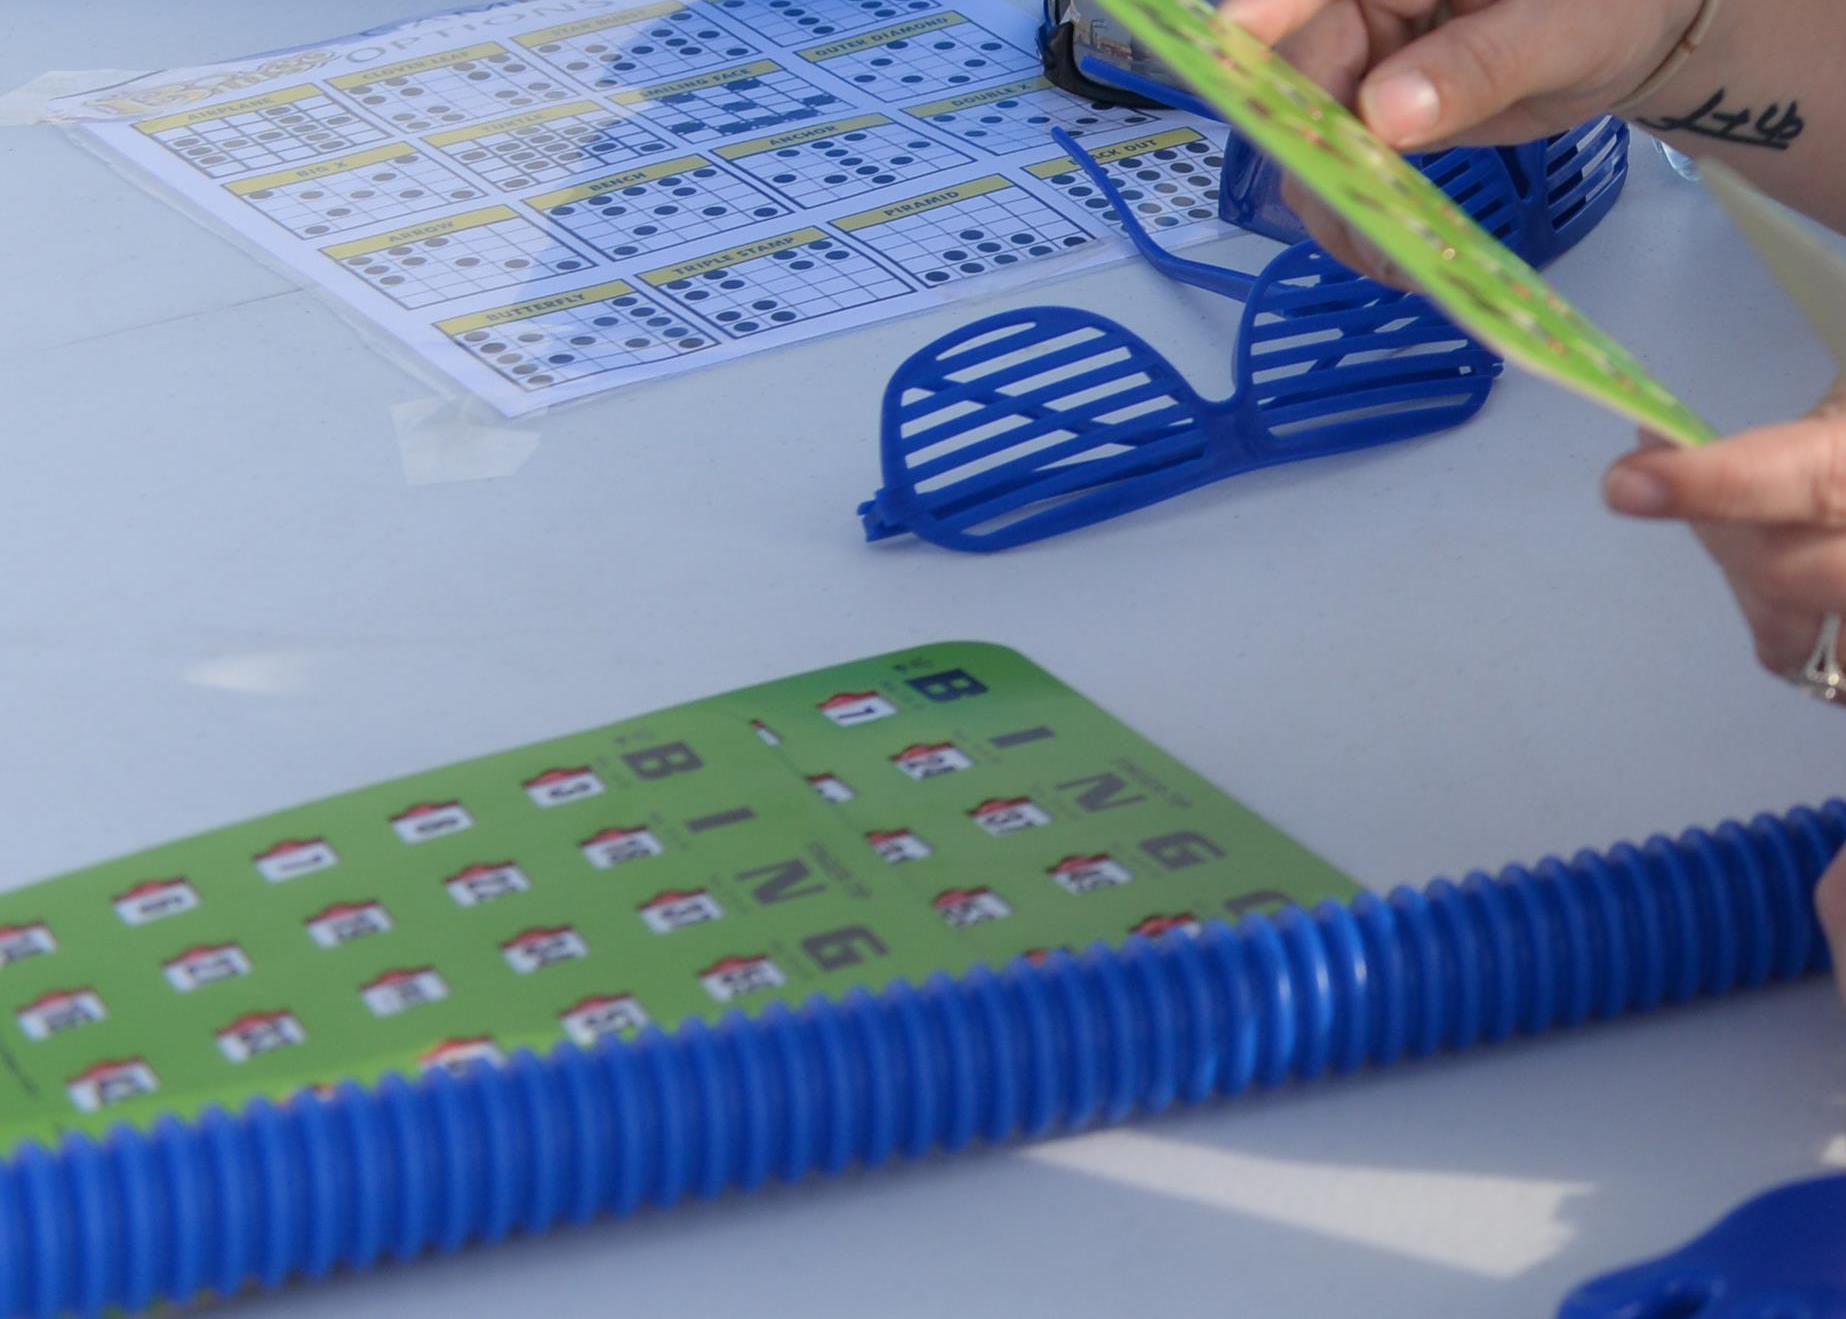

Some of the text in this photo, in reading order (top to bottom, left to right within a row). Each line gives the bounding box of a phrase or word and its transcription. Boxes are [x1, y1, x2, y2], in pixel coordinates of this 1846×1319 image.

[815, 16, 949, 58] OUTER DIAMOND
[701, 67, 752, 85] FACE
[187, 97, 274, 121] AIRPLANE
[951, 88, 1010, 108] DOUBLE
[768, 123, 838, 148] ANCHOR
[1126, 137, 1158, 156] OUT
[296, 162, 331, 179] BIG
[588, 170, 648, 192] BENCH
[883, 190, 960, 217] PIRAMID
[388, 220, 455, 243] ARROW
[672, 236, 796, 275] TRIPLE STAMP
[485, 292, 586, 321] BUTTERFLY
